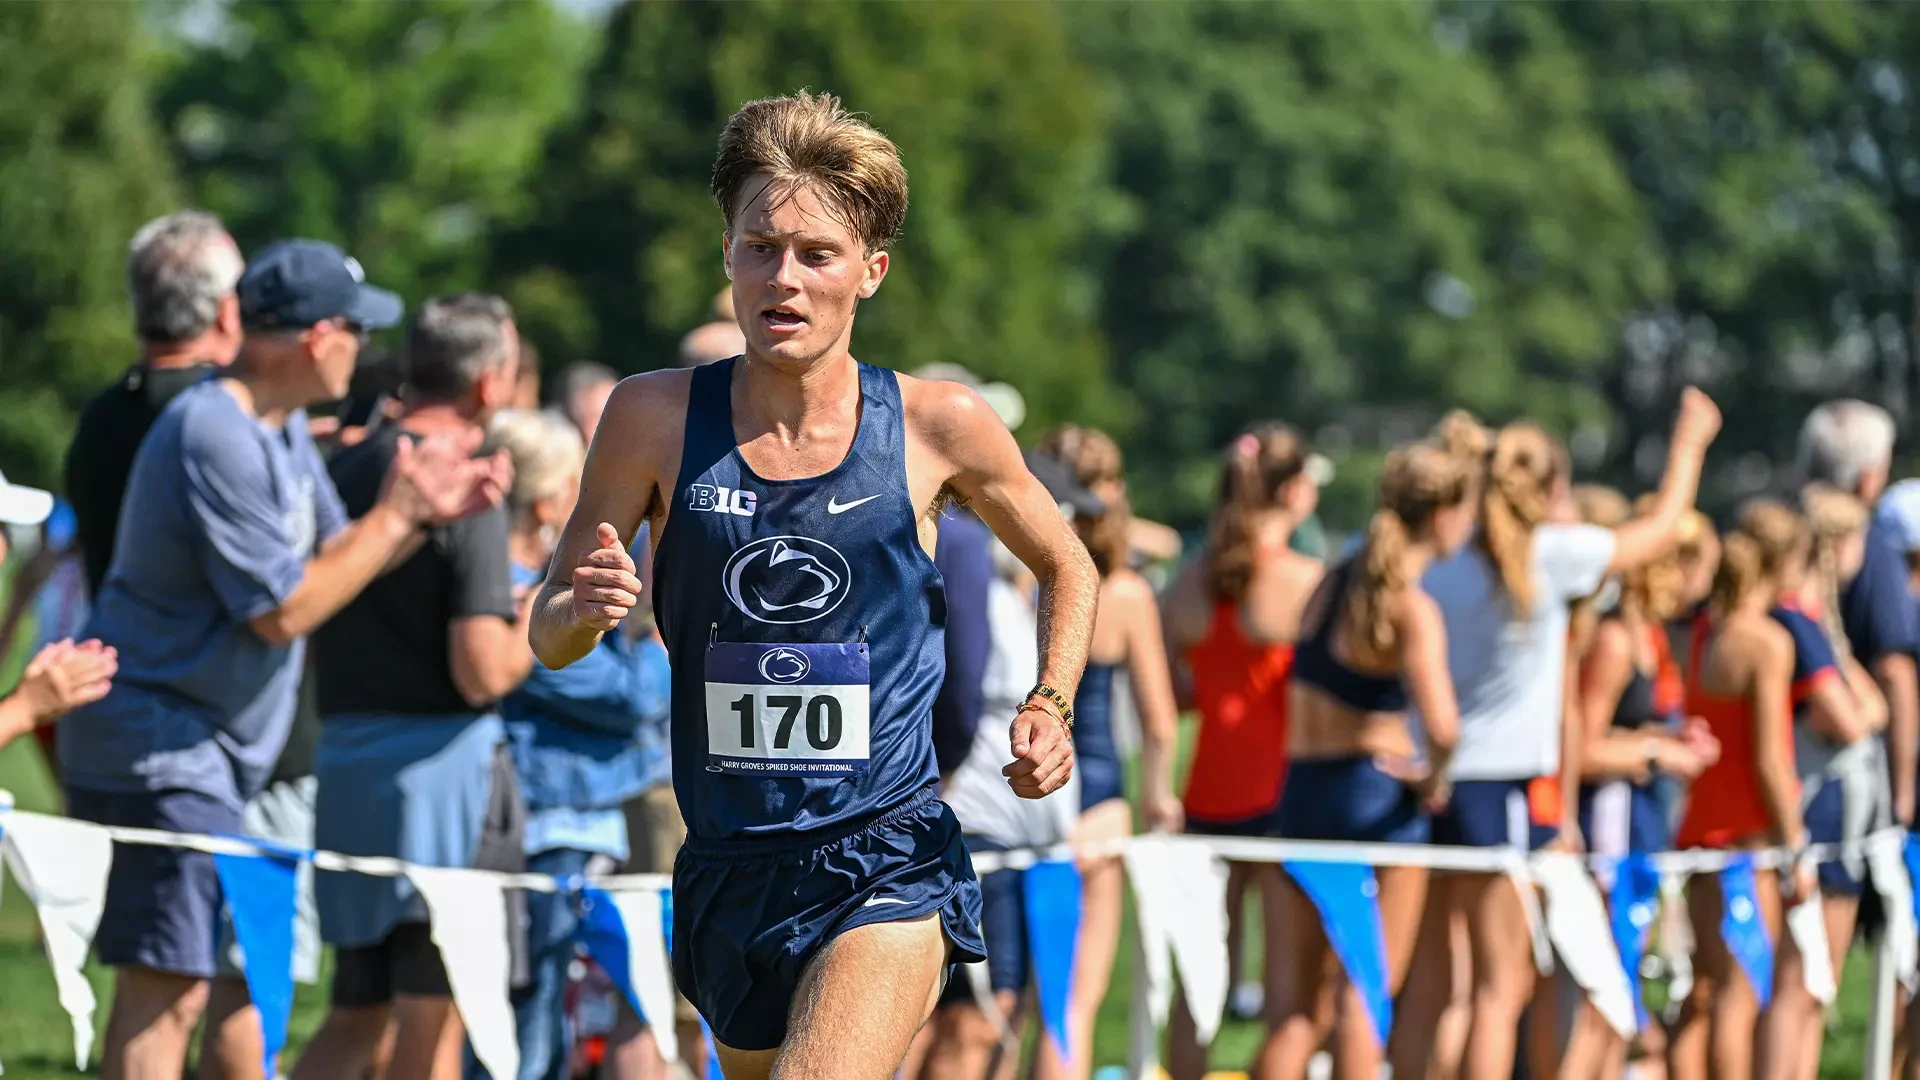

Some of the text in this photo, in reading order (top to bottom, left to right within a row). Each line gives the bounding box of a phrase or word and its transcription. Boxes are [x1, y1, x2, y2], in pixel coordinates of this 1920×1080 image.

[730, 693, 843, 751] 170
[721, 760, 854, 772] HARRY GROVES SPIKED SHOE INVITATIONAL
